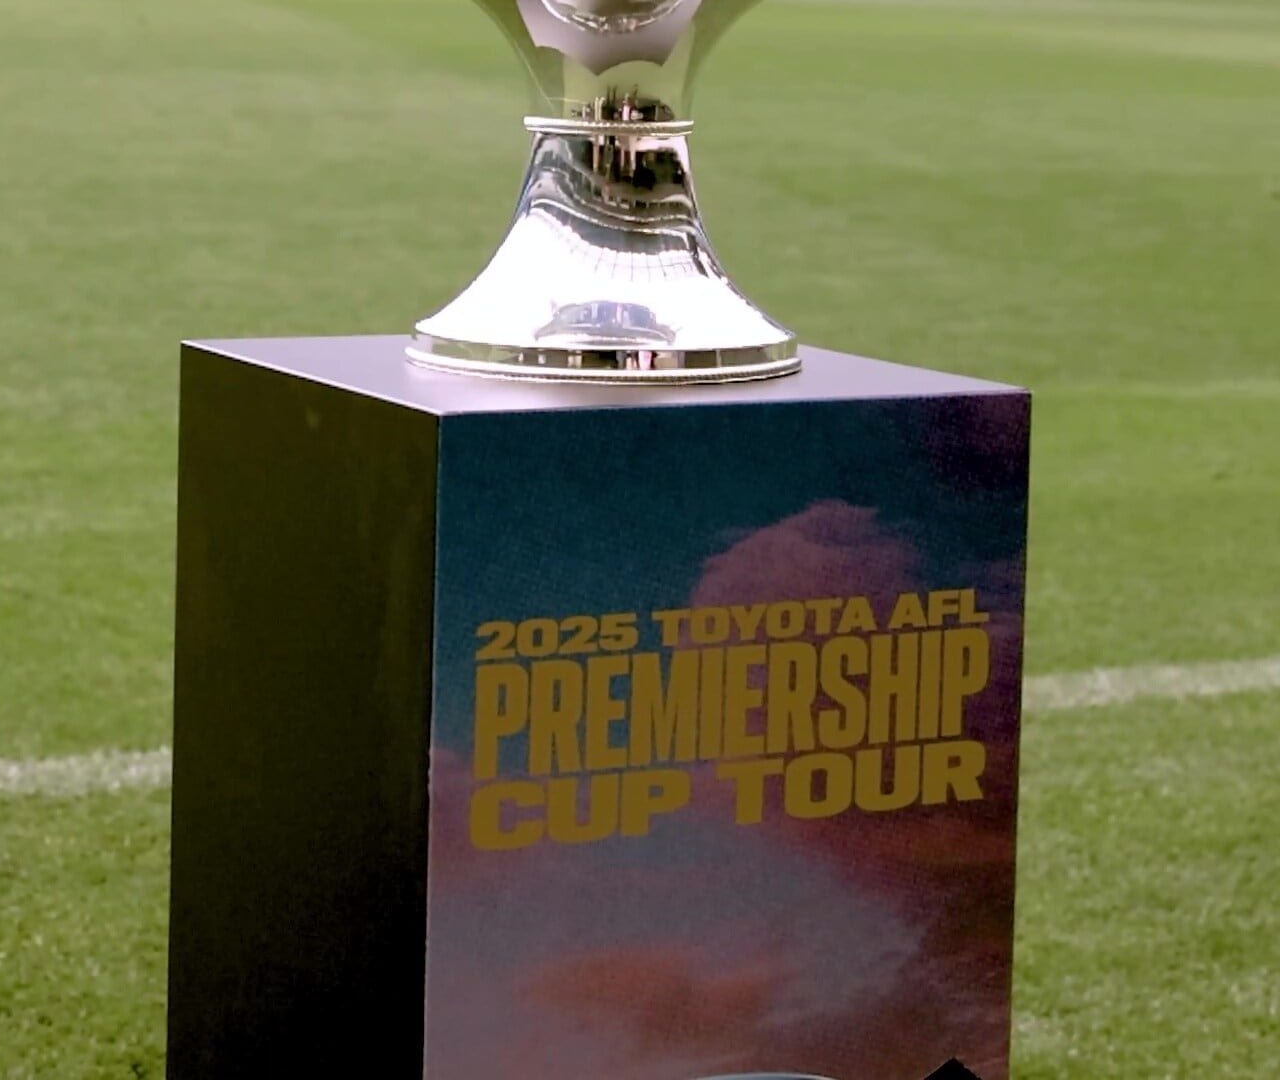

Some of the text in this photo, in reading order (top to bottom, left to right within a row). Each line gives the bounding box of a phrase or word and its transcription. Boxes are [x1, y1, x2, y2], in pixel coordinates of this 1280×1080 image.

[474, 588, 989, 662] 2025 TOYOTA AFL
[473, 628, 990, 780] PREMIERSHIP
[469, 741, 986, 851] CUP TOUR
